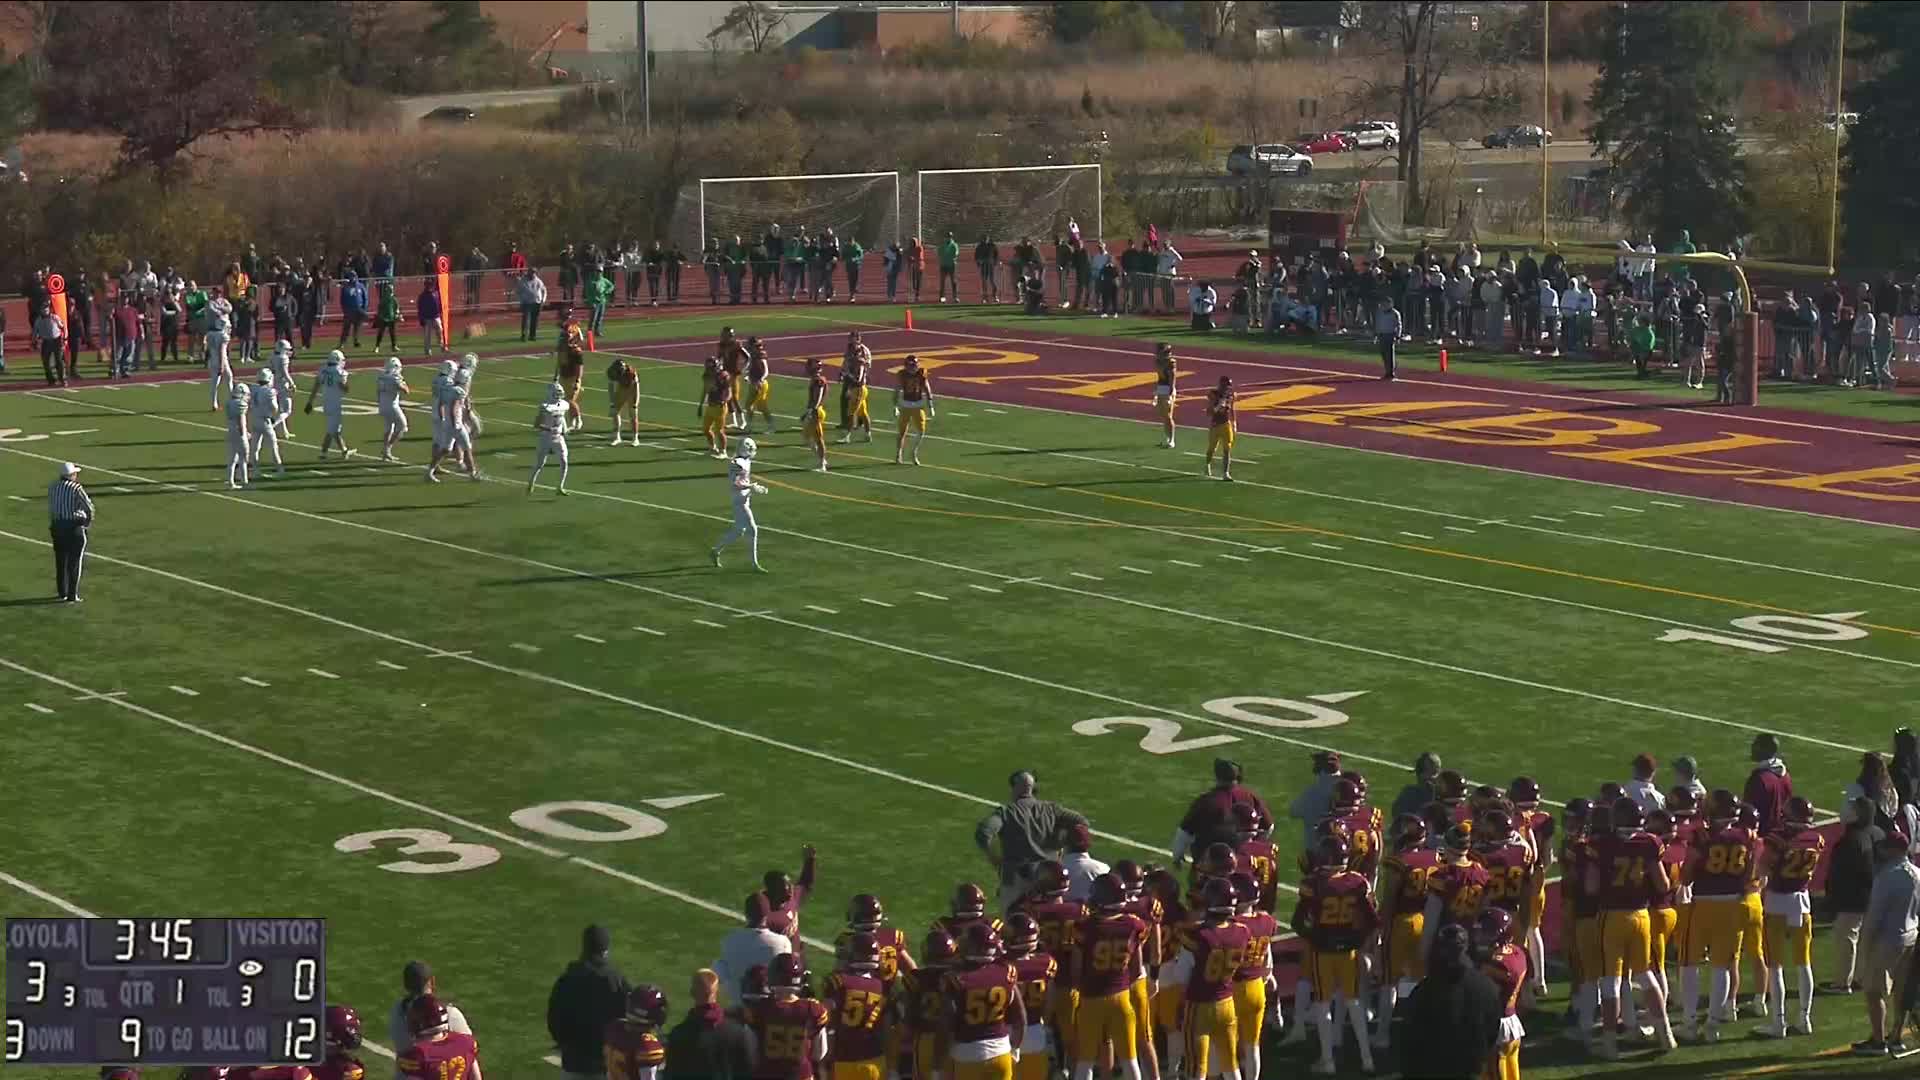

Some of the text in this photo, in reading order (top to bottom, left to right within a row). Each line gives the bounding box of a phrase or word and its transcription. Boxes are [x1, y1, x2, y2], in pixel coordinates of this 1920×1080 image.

[1655, 615, 1869, 653] 10
[1072, 696, 1349, 753] 20
[334, 801, 668, 873] 30
[841, 989, 885, 1029] 57
[964, 985, 1008, 1025] 52
